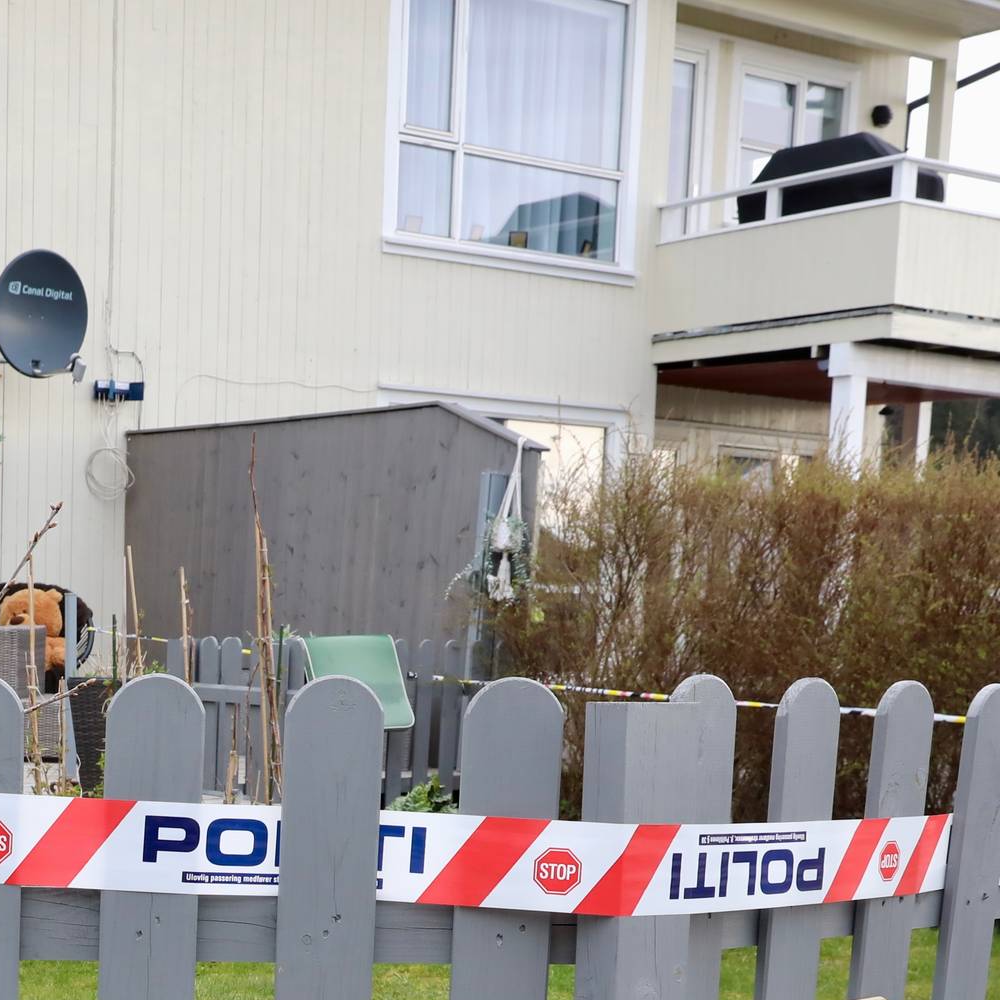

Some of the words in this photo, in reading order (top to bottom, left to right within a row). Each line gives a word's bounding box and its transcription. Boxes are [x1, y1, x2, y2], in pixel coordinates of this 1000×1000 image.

[22, 285, 44, 296] Canal
[45, 287, 73, 300] Digital
[142, 815, 427, 874] POTI
[880, 852, 900, 869] STOP
[185, 873, 209, 882] Ulovlig
[210, 874, 242, 883] passering
[539, 863, 577, 881] STOP
[669, 847, 826, 900] POLITI
